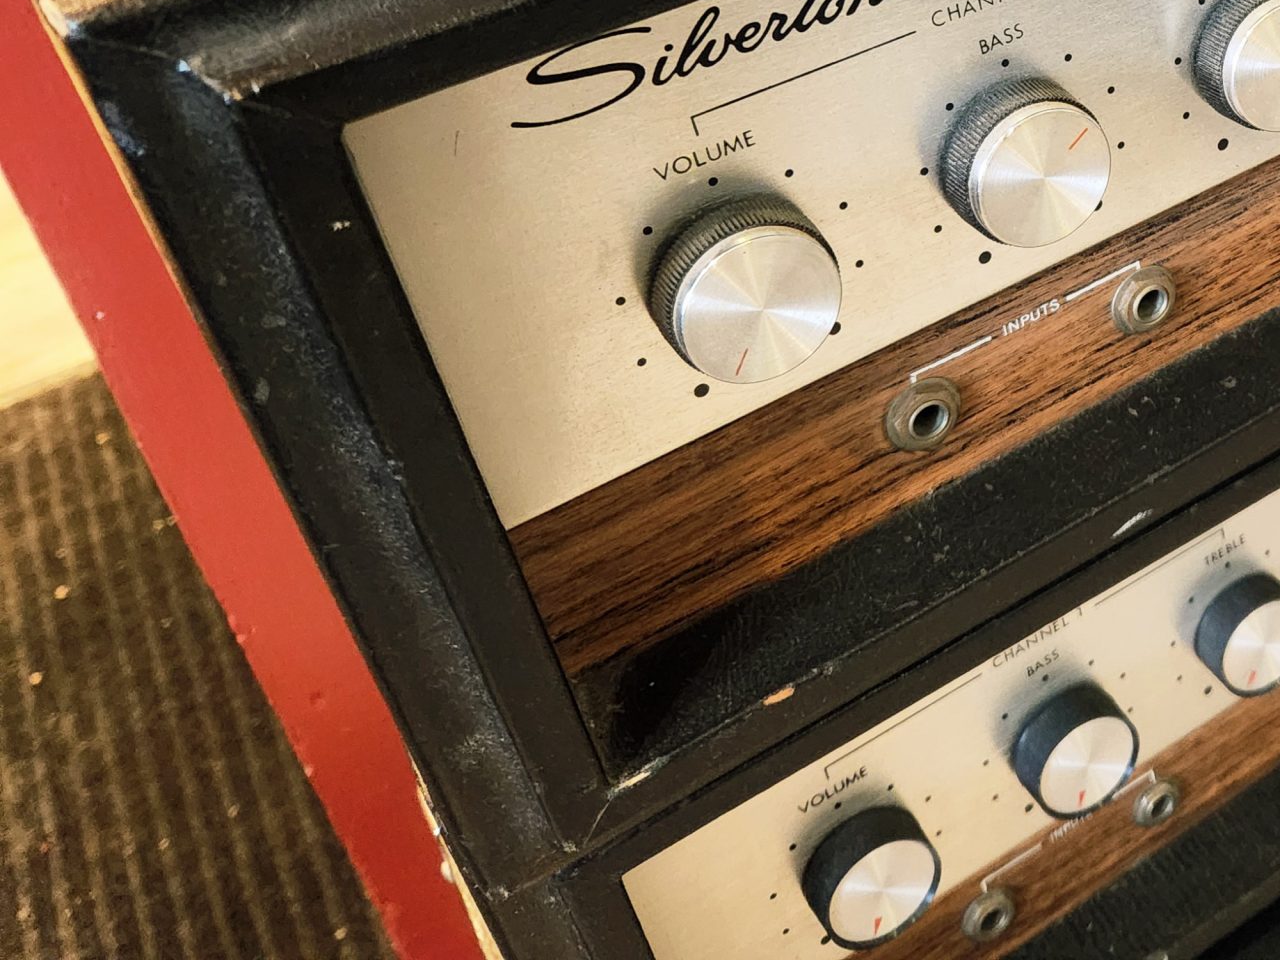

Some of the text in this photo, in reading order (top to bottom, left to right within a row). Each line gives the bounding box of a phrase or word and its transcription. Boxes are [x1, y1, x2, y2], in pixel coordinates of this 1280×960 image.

[978, 23, 1025, 55] BASS
[653, 129, 754, 181] VOLUME
[1001, 298, 1061, 337] INPUTS
[1204, 533, 1247, 566] TREBLE
[992, 617, 1070, 668] CHANNEL
[1026, 648, 1060, 678] BASS
[797, 764, 868, 814] VOLUME
